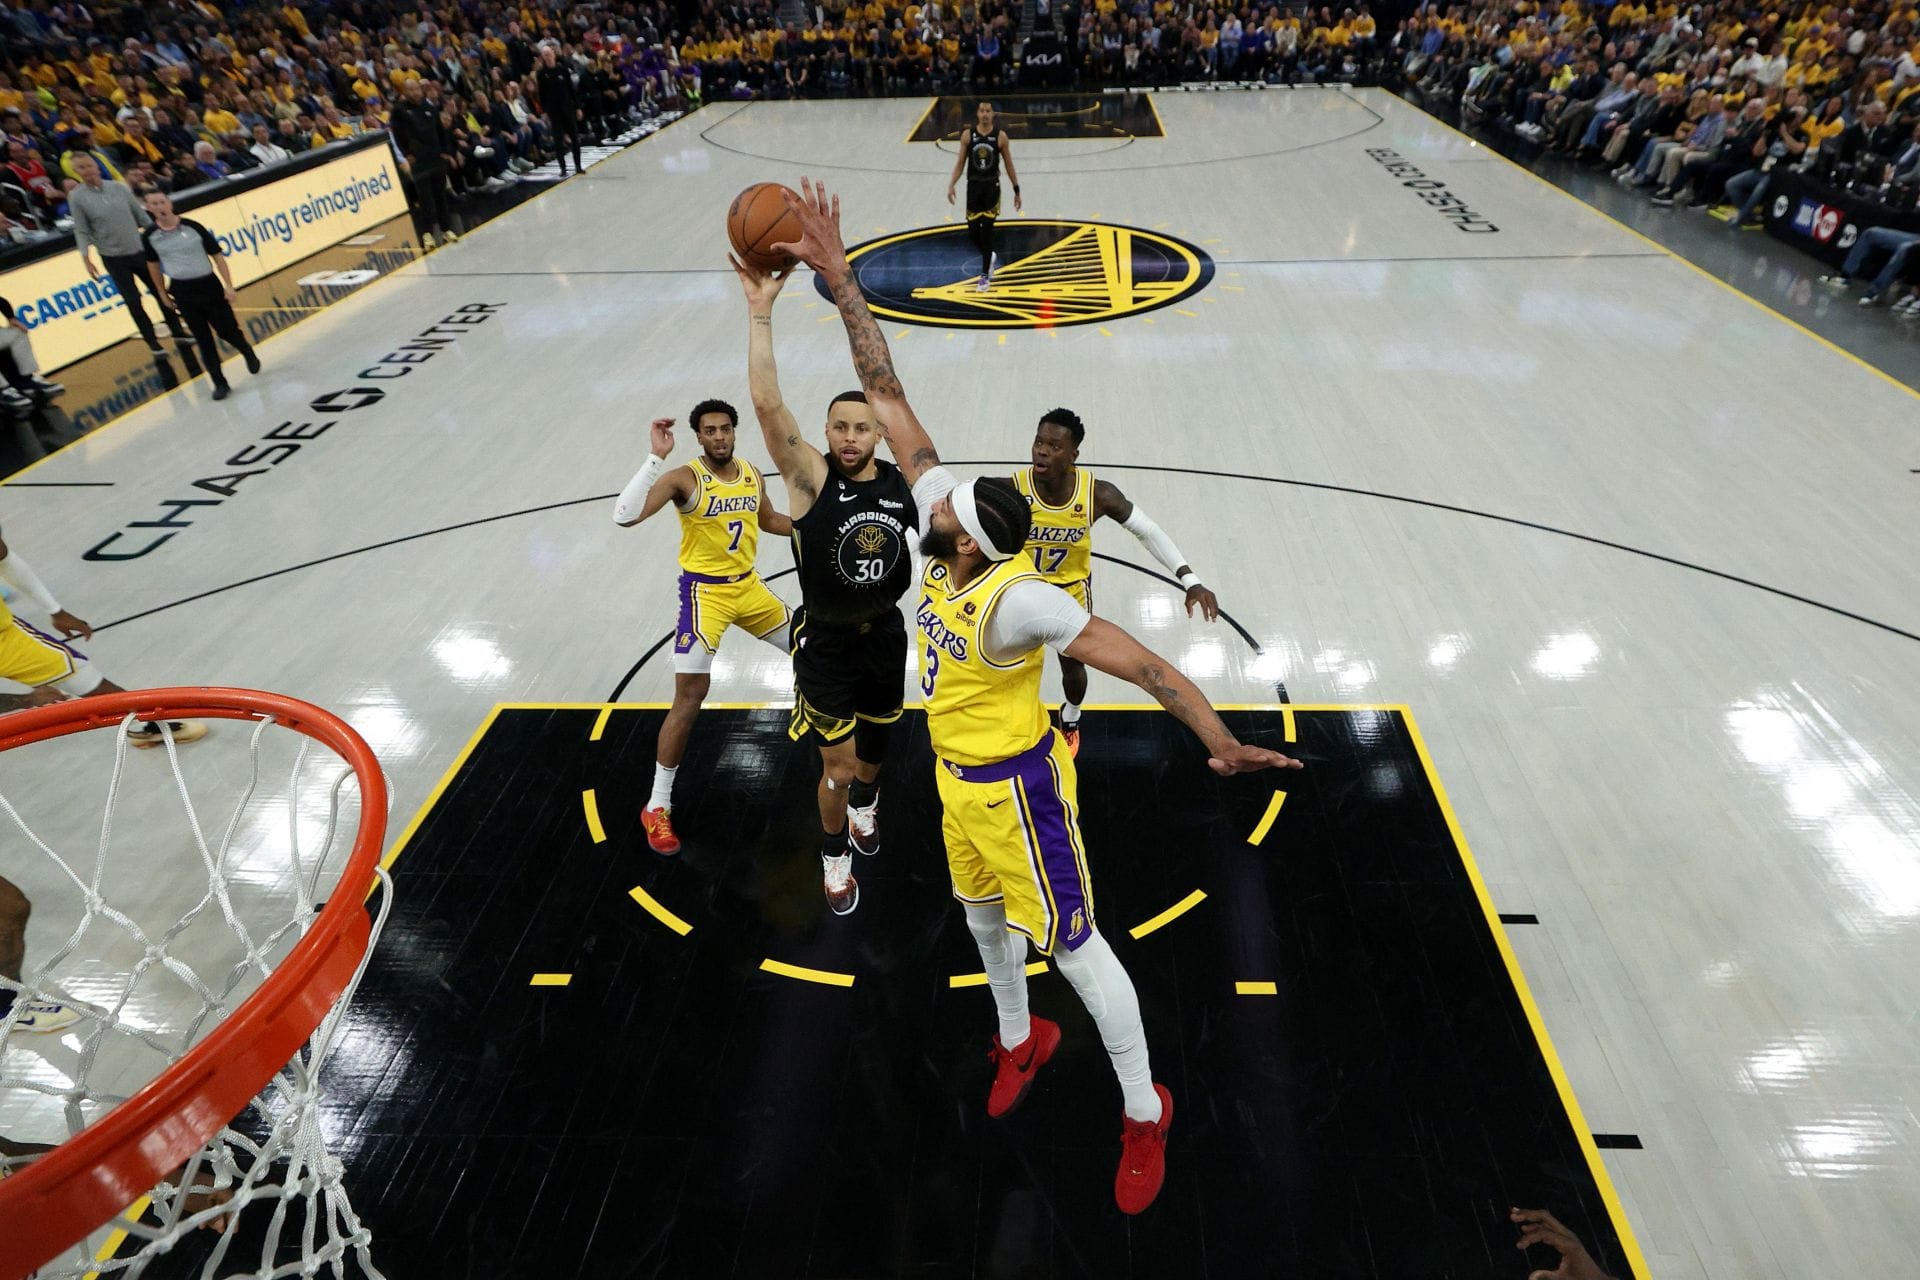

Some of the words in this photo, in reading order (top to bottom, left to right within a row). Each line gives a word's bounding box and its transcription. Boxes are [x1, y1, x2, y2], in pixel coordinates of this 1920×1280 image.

[209, 214, 292, 257] buying
[291, 164, 392, 229] reimagined
[1416, 190, 1500, 233] CHASE
[82, 420, 338, 561] CHASE
[357, 302, 508, 380] CENTER
[703, 495, 758, 518] LAKERS
[728, 520, 744, 551] 7
[838, 511, 904, 534] WARRIORS
[1029, 525, 1086, 543] AKERS
[854, 559, 884, 582] 30
[932, 565, 946, 580] 6
[1034, 546, 1068, 573] 17
[916, 594, 968, 661] LAKERS
[955, 611, 976, 627] bibigo
[921, 643, 940, 698] 3
